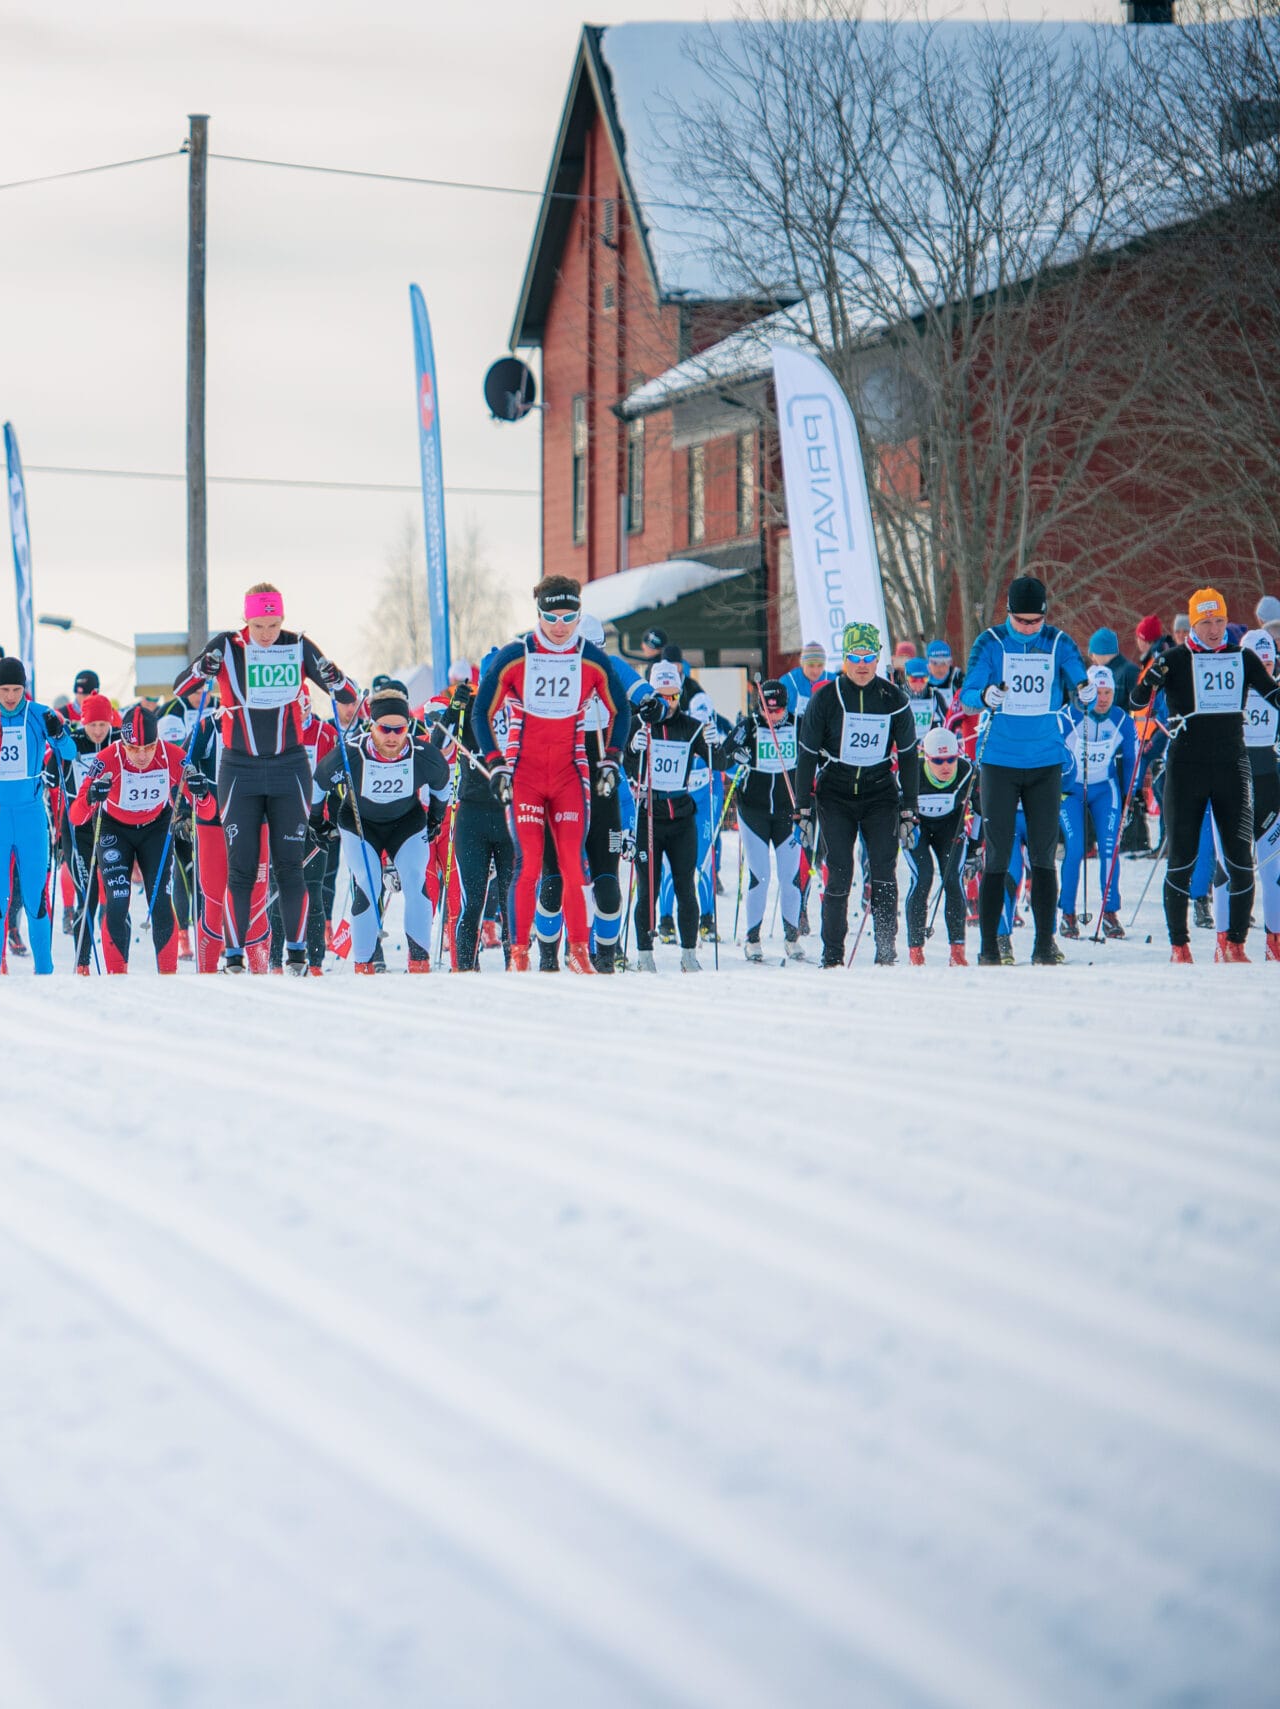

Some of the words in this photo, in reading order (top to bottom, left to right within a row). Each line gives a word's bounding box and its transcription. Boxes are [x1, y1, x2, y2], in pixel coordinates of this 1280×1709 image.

[251, 665, 297, 686] 1020
[1012, 675, 1045, 693] 303
[1204, 671, 1235, 690] 218
[535, 676, 570, 697] 212
[494, 718, 508, 735] 23
[850, 732, 879, 748] 294
[1, 746, 19, 762] 33
[760, 742, 794, 759] 1028
[654, 757, 679, 774] 301
[129, 787, 160, 801] 313
[372, 779, 403, 793] 222
